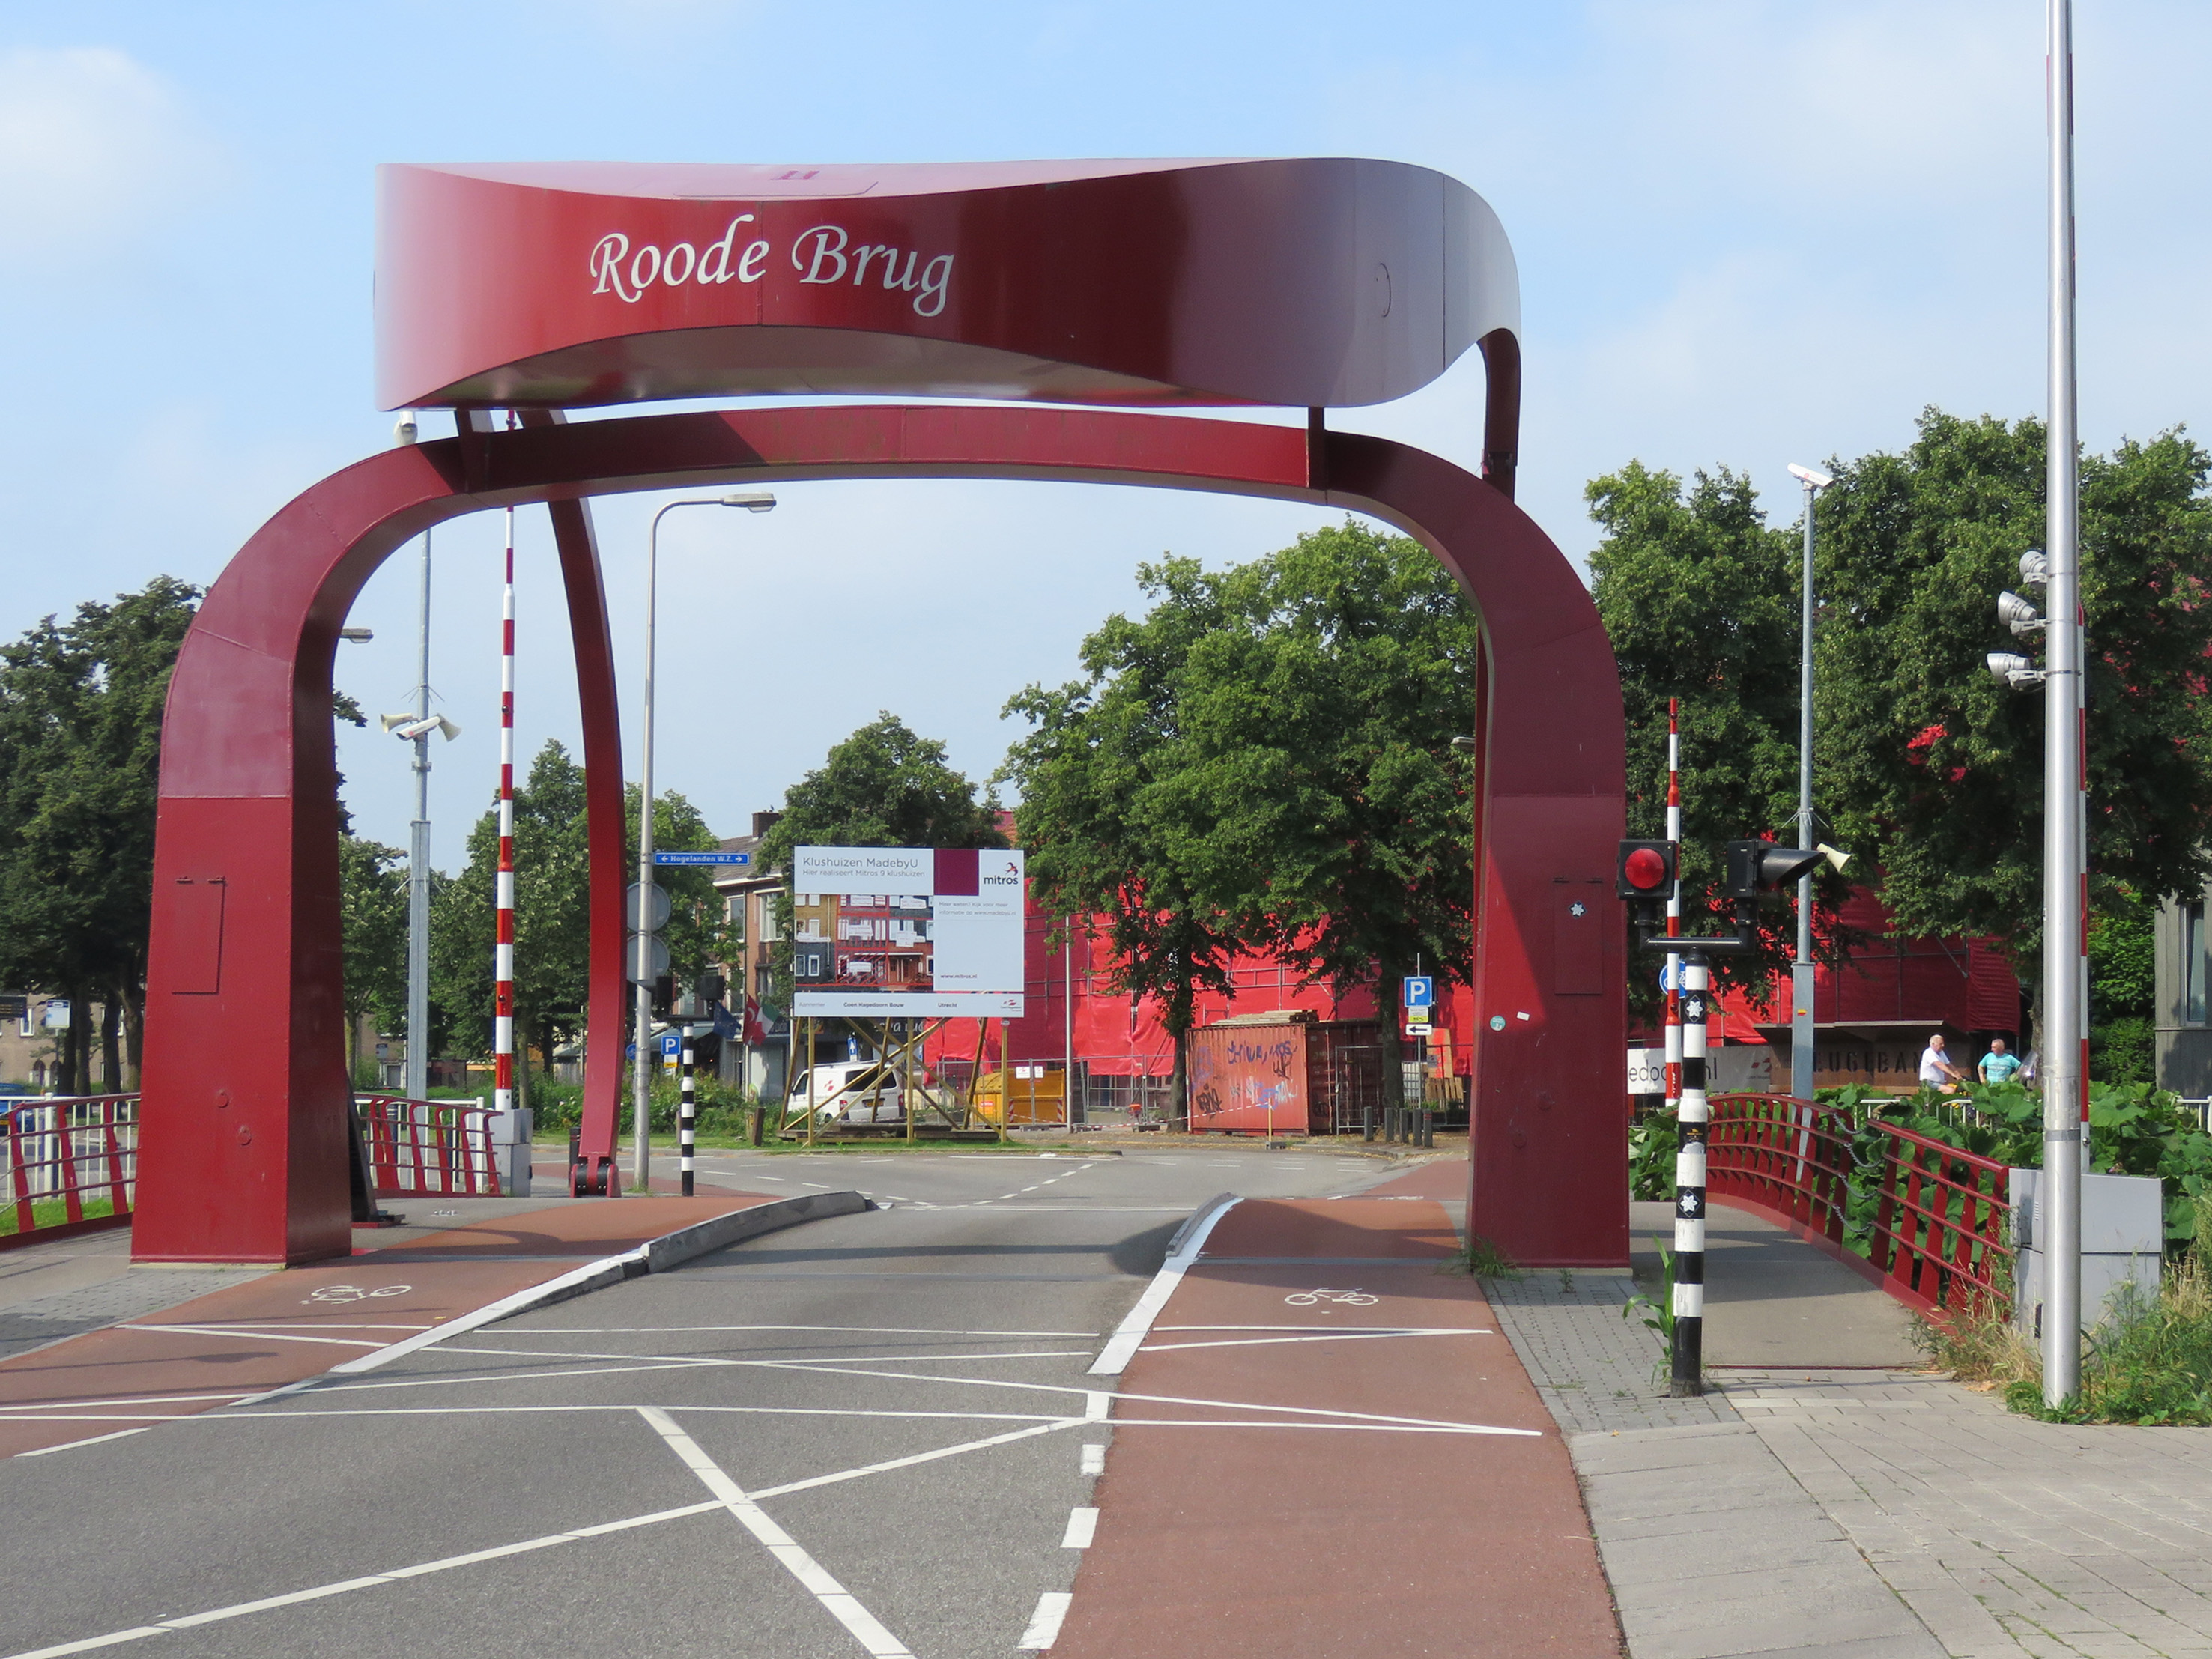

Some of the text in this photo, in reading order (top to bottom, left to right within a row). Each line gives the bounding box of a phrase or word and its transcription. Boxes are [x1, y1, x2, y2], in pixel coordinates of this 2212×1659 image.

[590, 213, 955, 318] Roode Brug
[670, 855, 716, 864] Hogelanden
[803, 856, 918, 870] Klushuizen MadebyU
[983, 875, 1019, 885] mitros
[1410, 980, 1426, 1004] P
[665, 1038, 676, 1053] P
